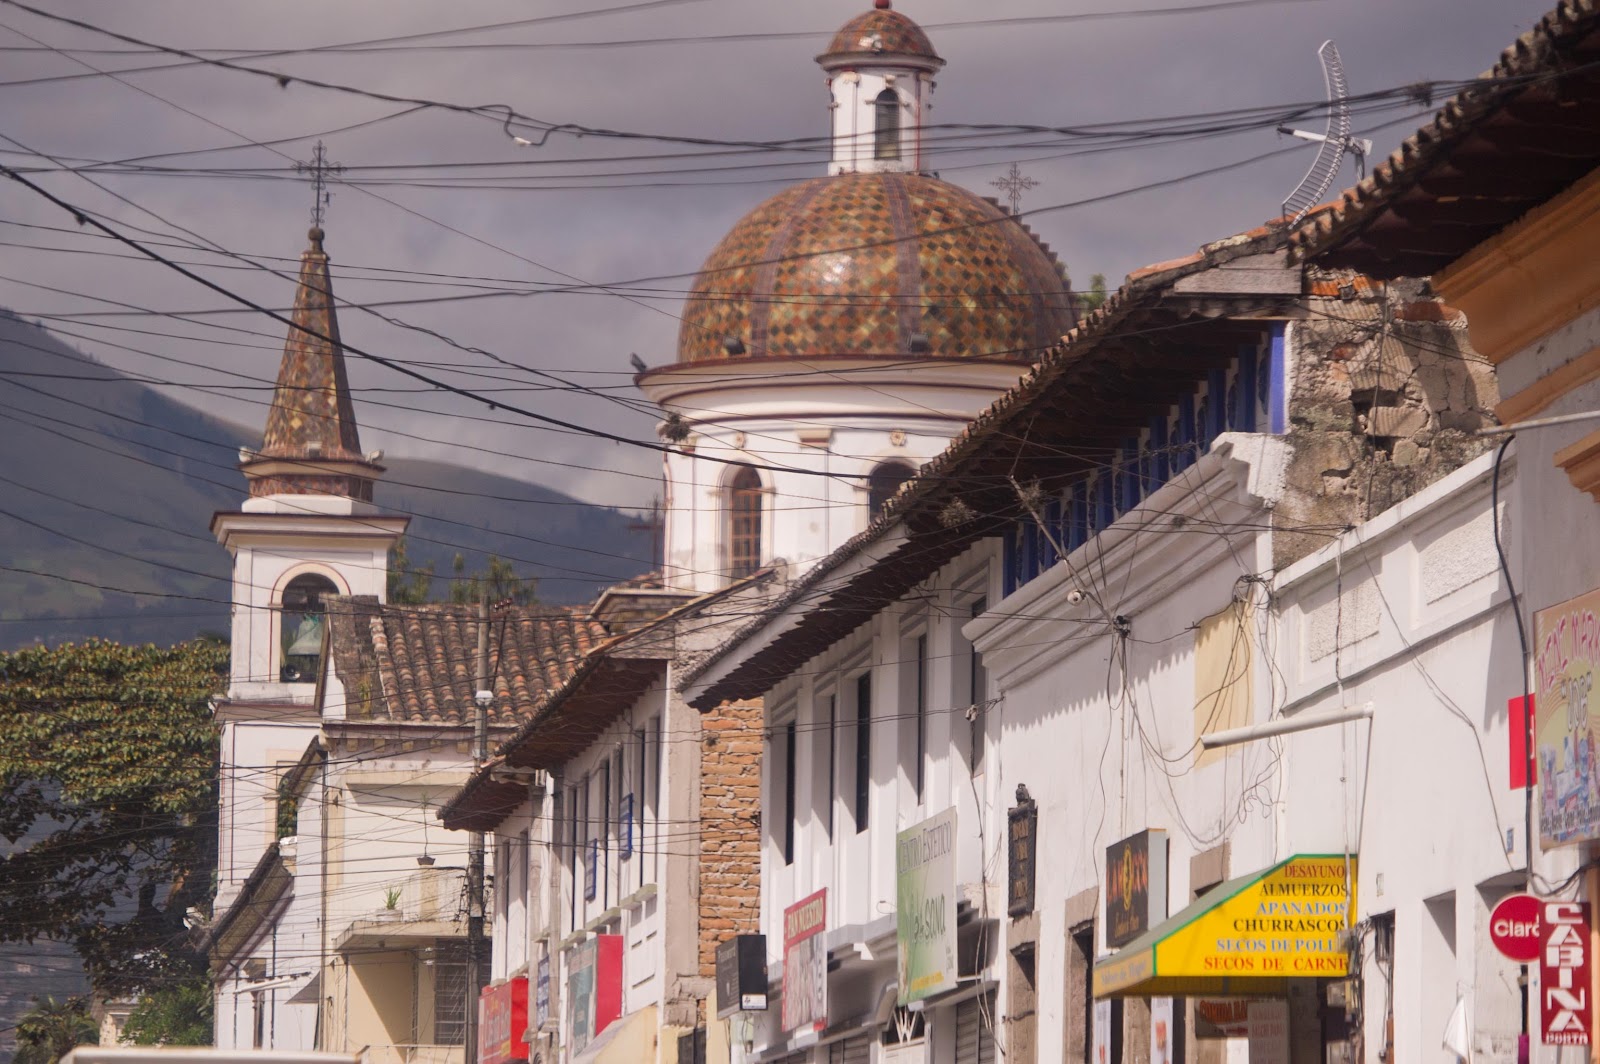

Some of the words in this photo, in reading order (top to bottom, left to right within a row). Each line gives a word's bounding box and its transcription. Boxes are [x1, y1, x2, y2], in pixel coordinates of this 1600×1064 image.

[1284, 864, 1345, 879] DESAYUNO
[1260, 883, 1347, 897] ALMUERZOS
[1257, 901, 1346, 916] APANADOS
[1233, 919, 1346, 932] CHURRASCOS
[1217, 938, 1267, 952] SECOS
[1271, 938, 1292, 952] DE
[1296, 938, 1335, 952] POLL
[1204, 957, 1255, 971] SECOS
[1263, 957, 1283, 971] DE
[1293, 957, 1347, 971] CARNE
[1545, 903, 1585, 1032] CABINA
